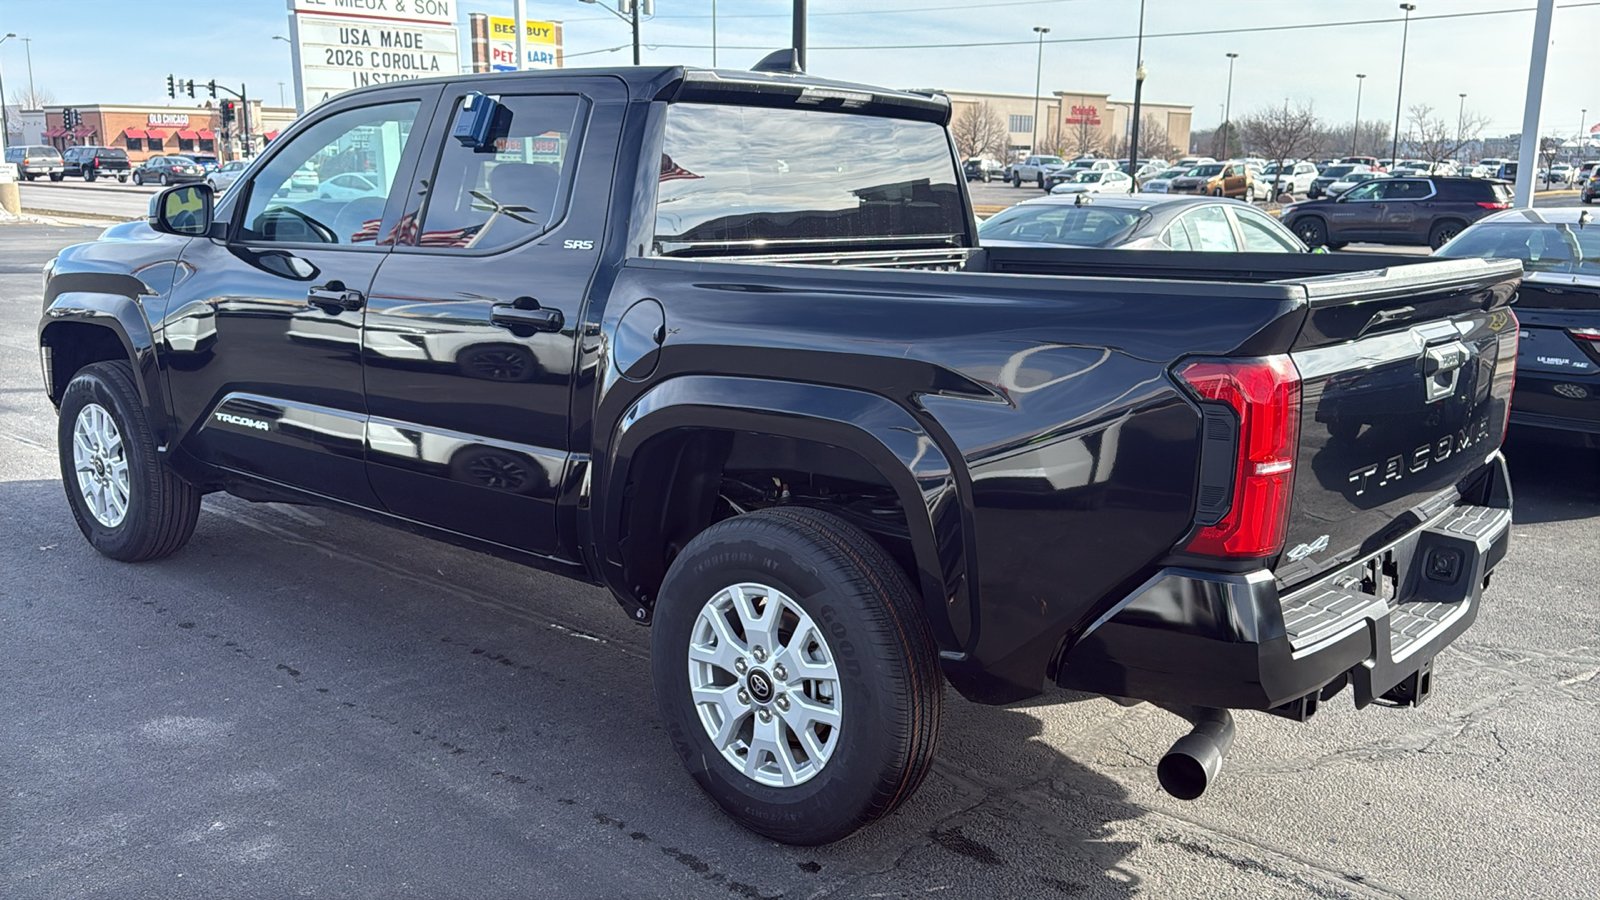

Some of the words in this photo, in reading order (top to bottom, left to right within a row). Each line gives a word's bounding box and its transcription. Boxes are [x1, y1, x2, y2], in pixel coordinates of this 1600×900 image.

[415, 0, 449, 16] SON
[340, 27, 371, 46] USA
[380, 30, 423, 49] MADE
[494, 23, 516, 34] BES
[526, 26, 551, 38] BUY
[325, 48, 364, 67] 2026
[371, 51, 440, 71] COROLLA
[353, 71, 419, 87] INSTO
[149, 113, 162, 124] OLD
[163, 113, 189, 124] CHICAGO
[496, 139, 521, 152] HOBB
[563, 239, 594, 250] SR5
[214, 412, 269, 432] TACOMA
[1349, 415, 1489, 496] TACOMA
